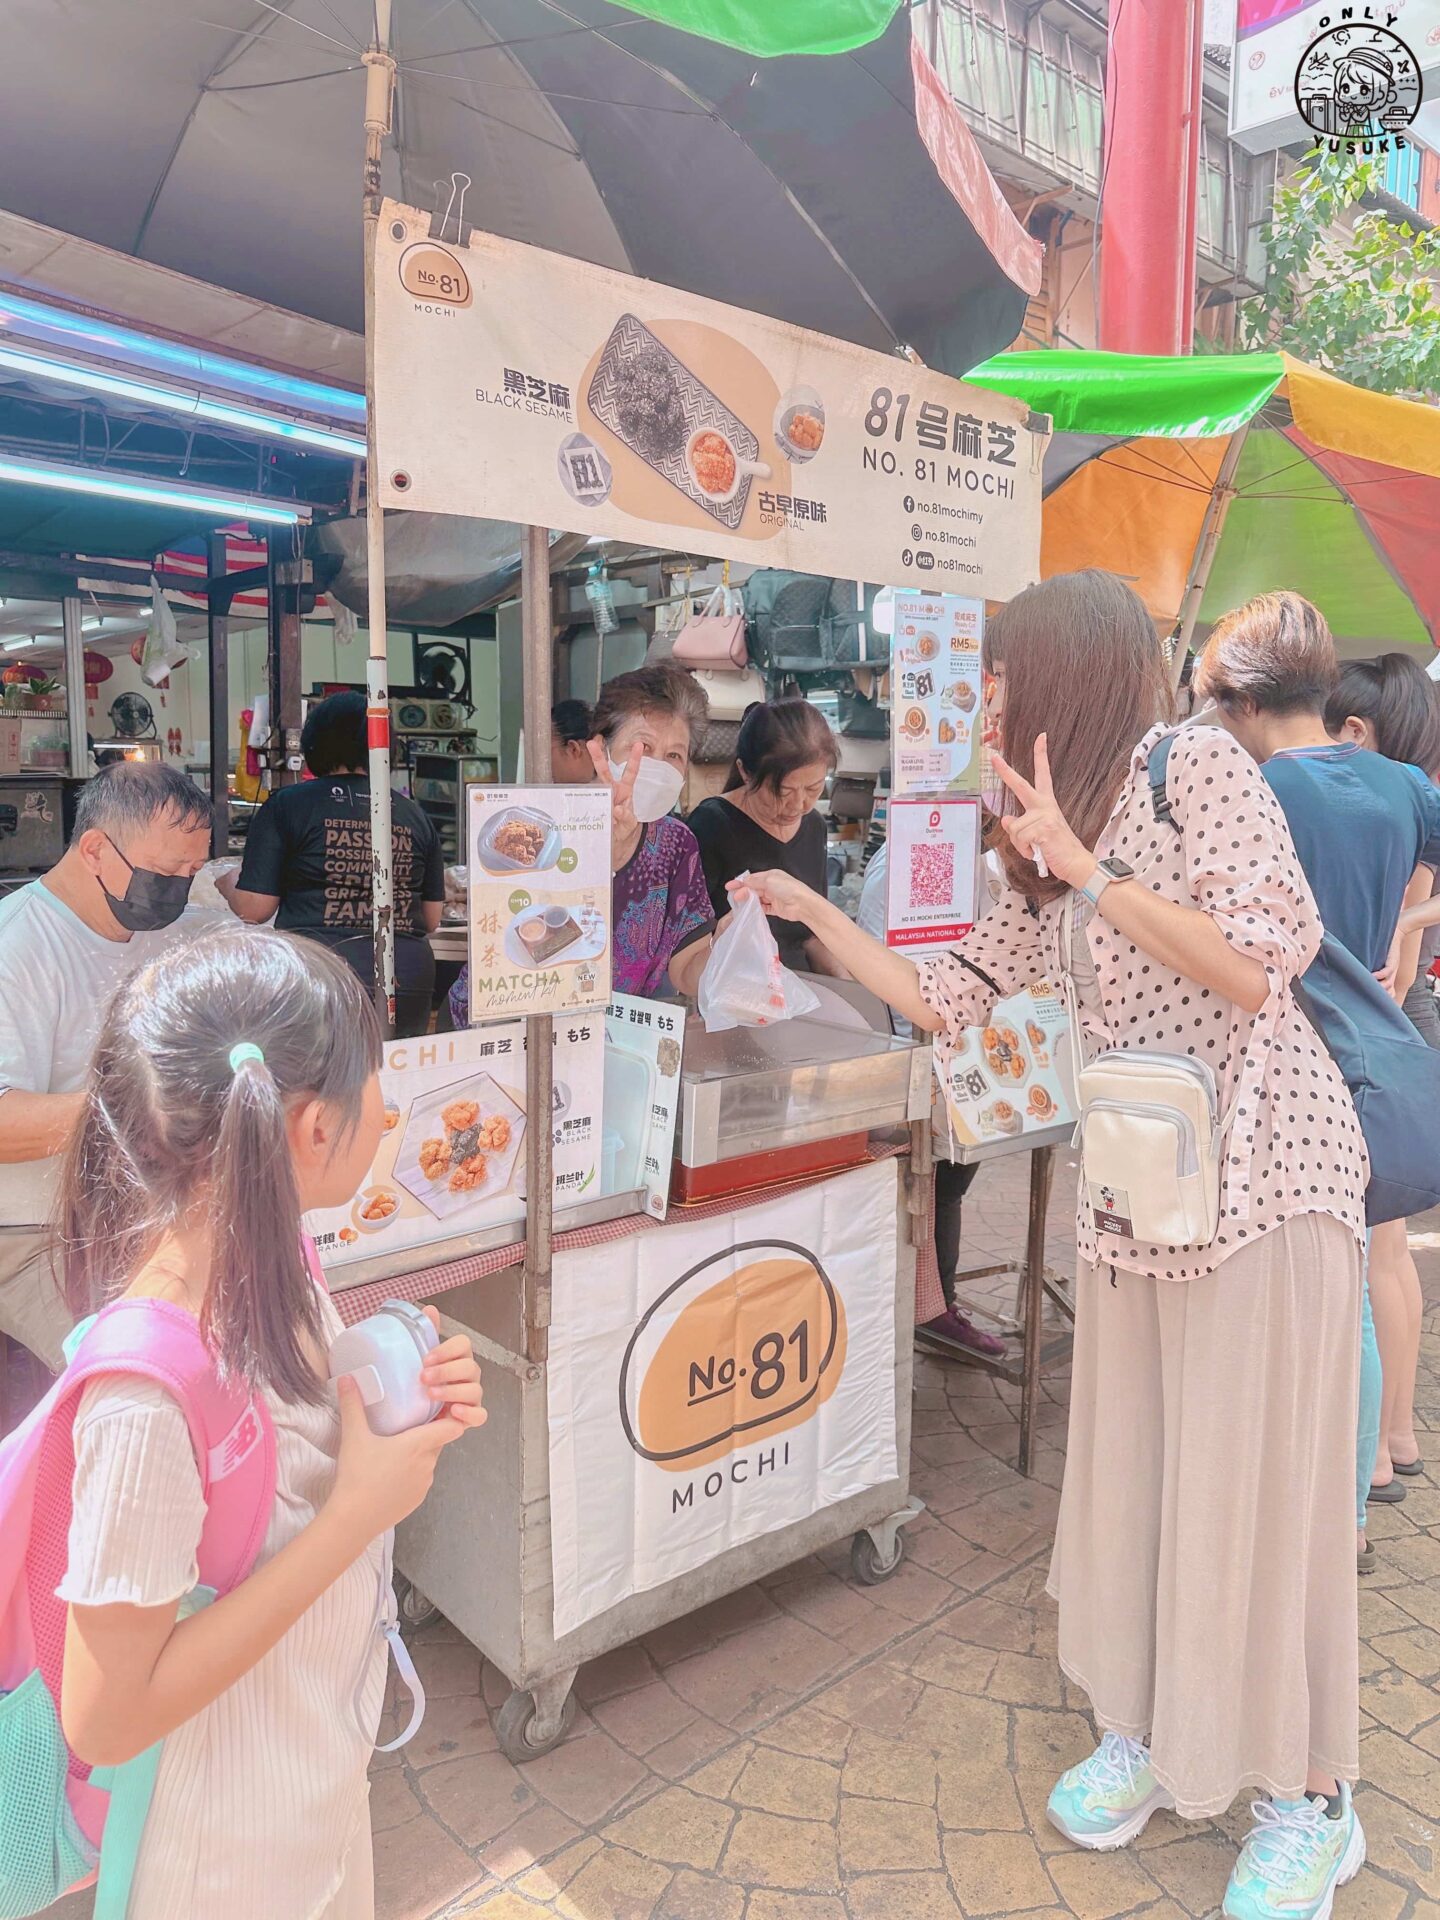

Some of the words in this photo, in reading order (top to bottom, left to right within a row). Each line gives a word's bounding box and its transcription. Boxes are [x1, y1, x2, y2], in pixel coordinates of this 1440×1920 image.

[414, 303, 457, 318] MOCHI
[502, 367, 571, 409] 黑芝麻
[476, 388, 522, 409] BLACK
[525, 400, 573, 424] SESAME
[864, 386, 1017, 468] 81号麻芝
[863, 446, 903, 477] NO.
[914, 458, 937, 483] 81
[947, 465, 1015, 501] MOCHI
[758, 490, 828, 524] 古早原味
[917, 501, 983, 524] no.81mochimy
[759, 513, 805, 531] ORIGINAL
[925, 530, 977, 548] no.81mochi
[937, 558, 983, 575] no81mochi
[950, 636, 970, 650] RM5
[547, 822, 577, 833] Matcha
[578, 820, 605, 831] mochi
[325, 829, 413, 852] PASSON
[324, 860, 413, 876] COMMITY
[323, 901, 413, 920] FAMLY
[933, 911, 961, 920] ENTERPRISE
[895, 931, 926, 941] MALAYSIA
[926, 929, 956, 939] NATIONAL
[956, 928, 966, 936] QR
[478, 970, 562, 993] MATCHA
[577, 973, 596, 981] NEW
[486, 984, 539, 1008] moment
[657, 1015, 674, 1031] もち
[567, 1026, 591, 1043] もち
[389, 1040, 454, 1071] CHI
[480, 1038, 513, 1057] 麻芝
[652, 1103, 669, 1118] 芝麻
[563, 1116, 592, 1131] 黑芝麻
[566, 1126, 593, 1137] BLACK
[561, 1133, 592, 1146] SESAME
[556, 1170, 585, 1186] 班兰叶
[318, 1239, 353, 1252] RANGE
[672, 1441, 789, 1514] MOCHI
